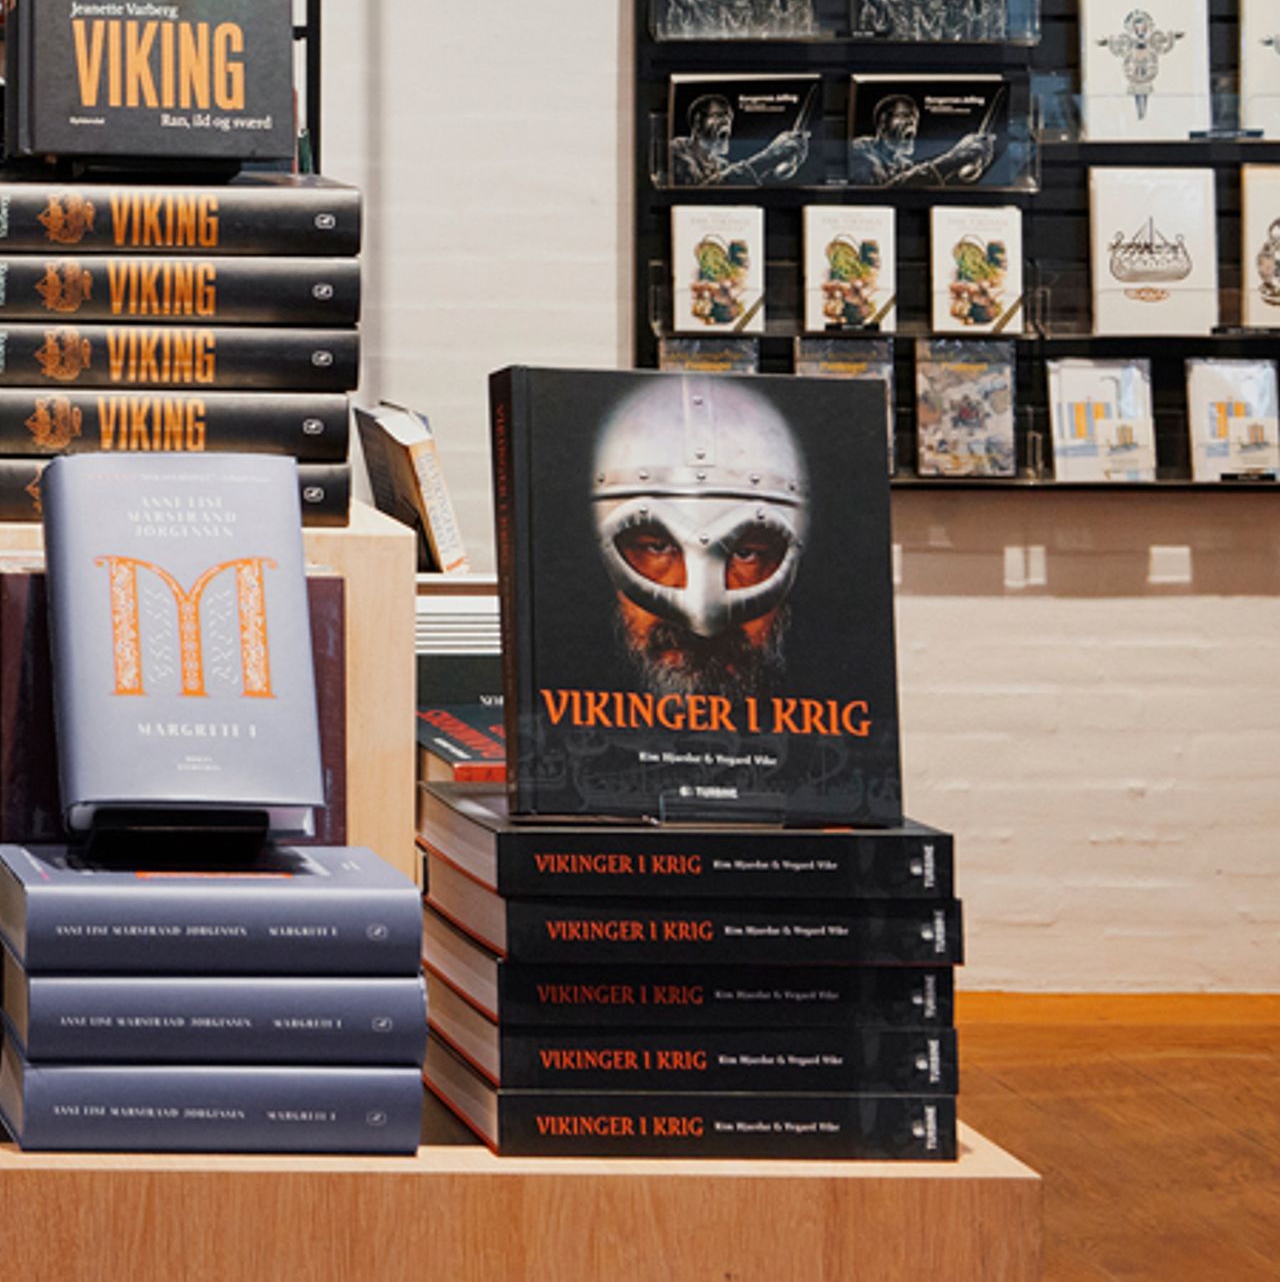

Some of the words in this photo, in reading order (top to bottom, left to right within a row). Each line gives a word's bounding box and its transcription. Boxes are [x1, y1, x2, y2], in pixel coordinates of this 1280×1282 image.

[70, 1, 124, 18] Jeanette
[126, 2, 178, 19] Varberg
[72, 19, 245, 110] VIKING
[161, 114, 190, 129] Ran,
[192, 114, 211, 128] ild
[213, 118, 231, 131] og
[233, 115, 272, 129] sværd
[110, 191, 219, 247] VIKING
[107, 259, 216, 315] VIKING
[107, 328, 216, 384] VIKING
[97, 394, 206, 450] VIKING
[541, 689, 737, 732] VIKINGER
[747, 698, 760, 733] I
[772, 697, 871, 736] KRIG
[534, 854, 635, 874] VIKINGER
[638, 855, 646, 873] I
[652, 854, 702, 874] KRIG
[546, 921, 647, 941] VIKINGER
[650, 922, 658, 940] I
[664, 921, 714, 941] KRIG
[536, 985, 637, 1005] VIKINGER
[640, 986, 648, 1004] I
[654, 985, 704, 1005] KRIG
[539, 1050, 640, 1070] VIKINGER
[643, 1051, 651, 1069] I
[657, 1050, 707, 1070] KRIG
[535, 1116, 636, 1136] VIKINGER
[639, 1117, 647, 1135] I
[653, 1116, 703, 1136] KRIG
